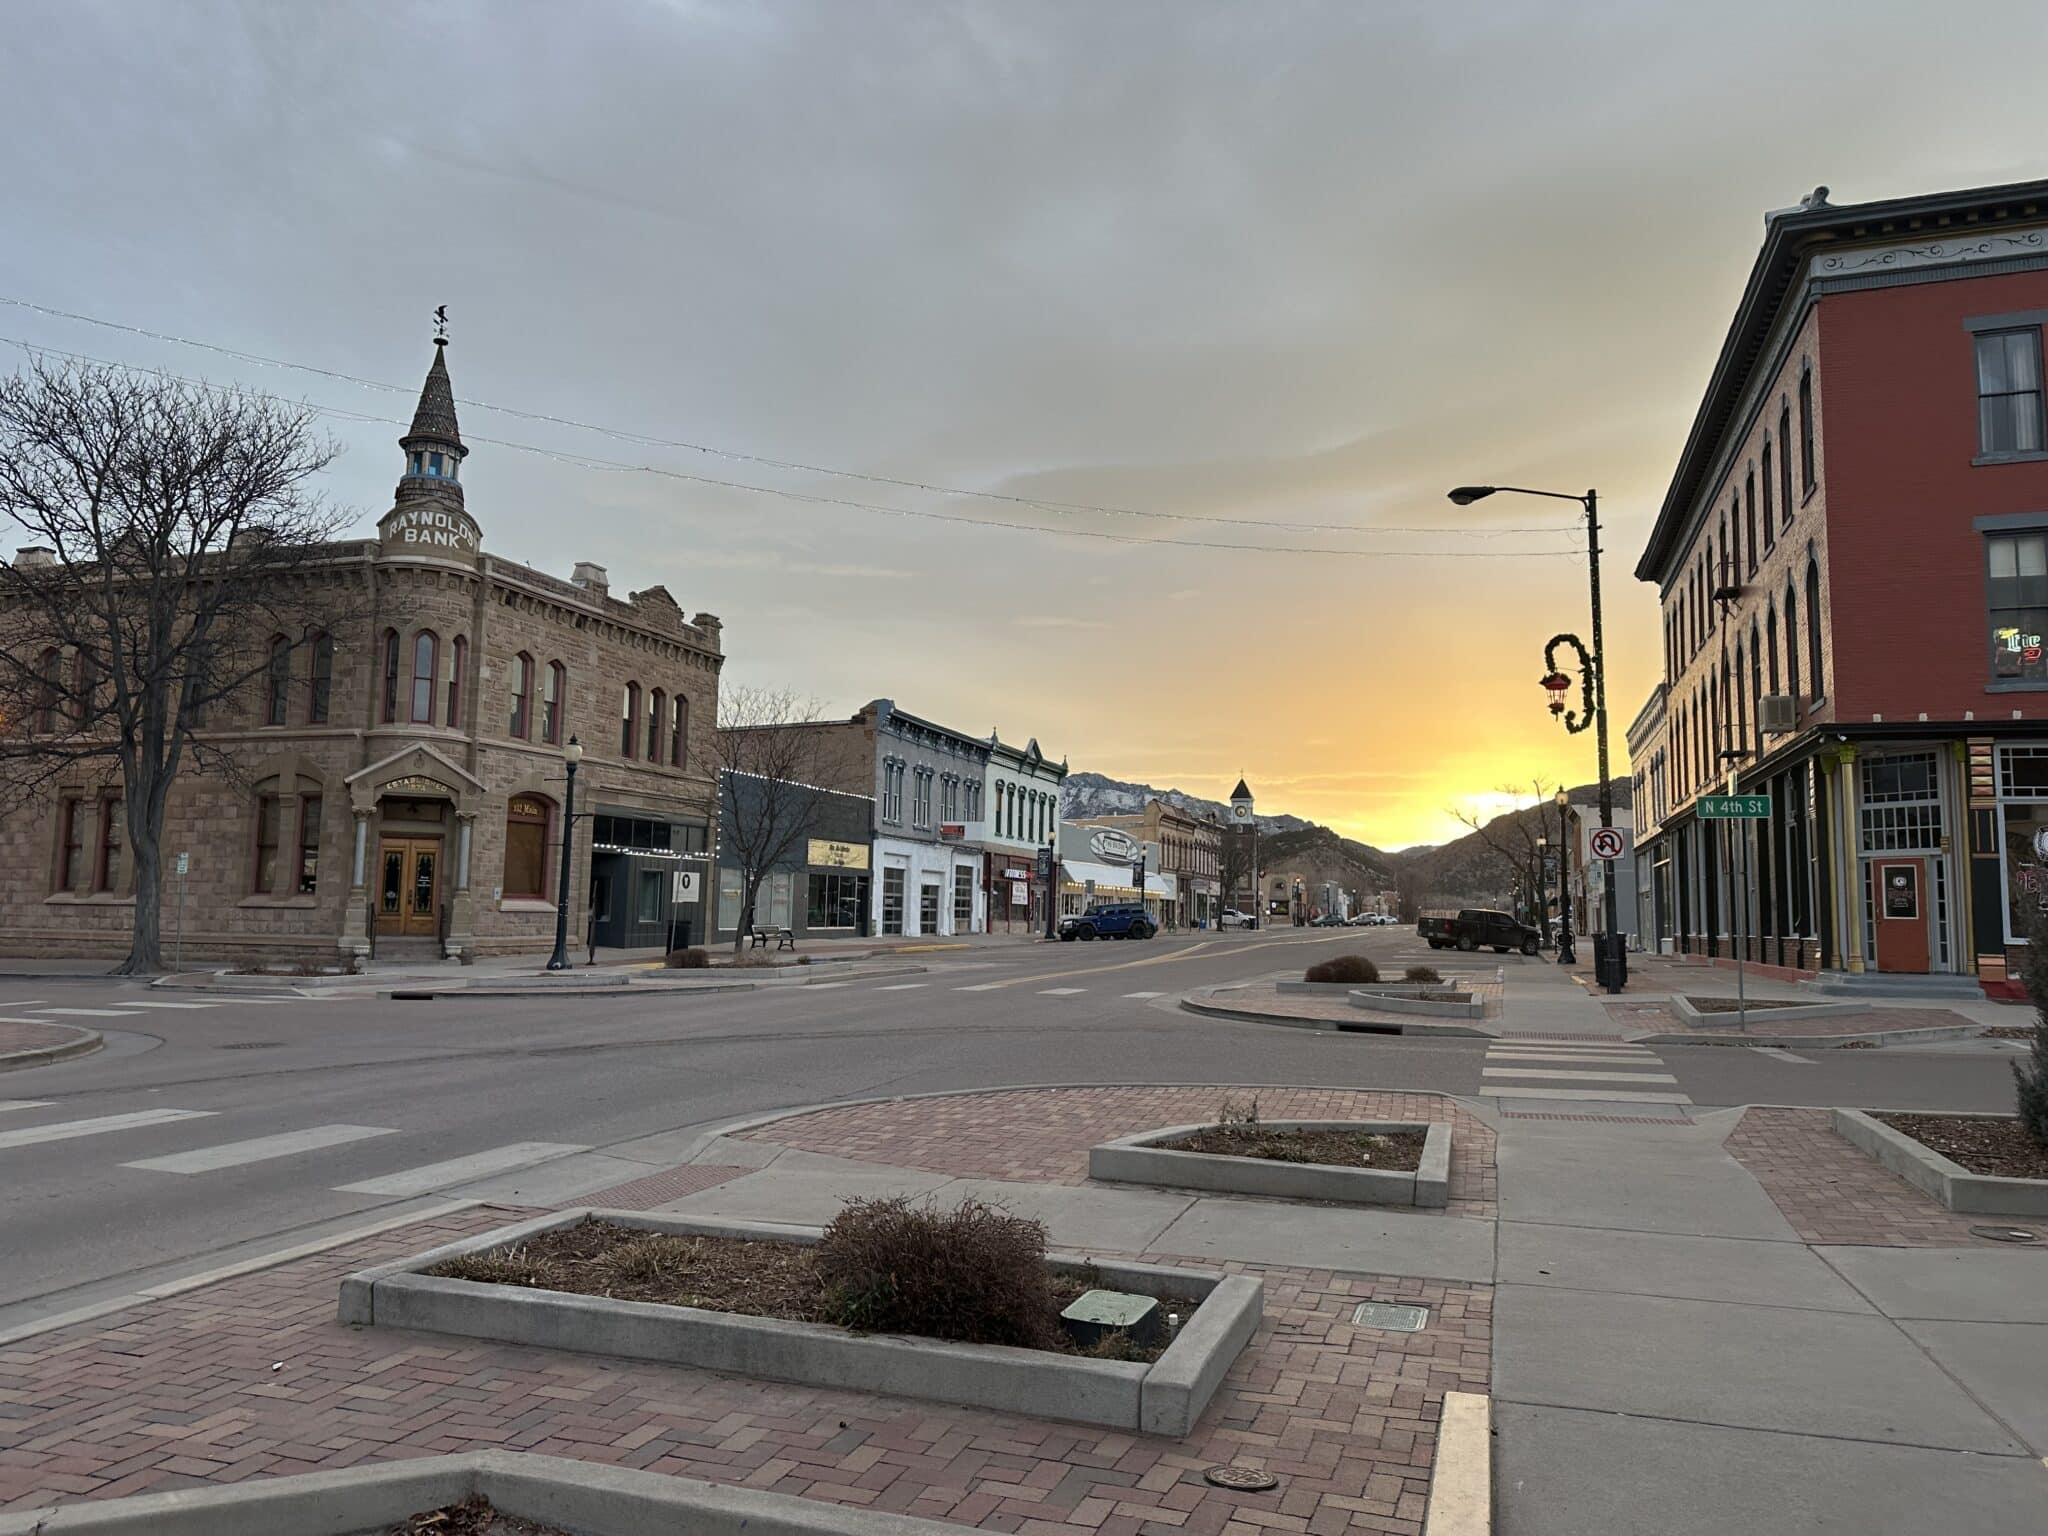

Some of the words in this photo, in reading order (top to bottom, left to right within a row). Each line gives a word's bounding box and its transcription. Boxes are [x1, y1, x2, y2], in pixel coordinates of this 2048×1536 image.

[389, 511, 474, 548] RAYNOLDS
[404, 528, 460, 549] BANK
[1705, 801, 1714, 814] N
[1720, 801, 1743, 814] 4th
[1748, 800, 1762, 814] St
